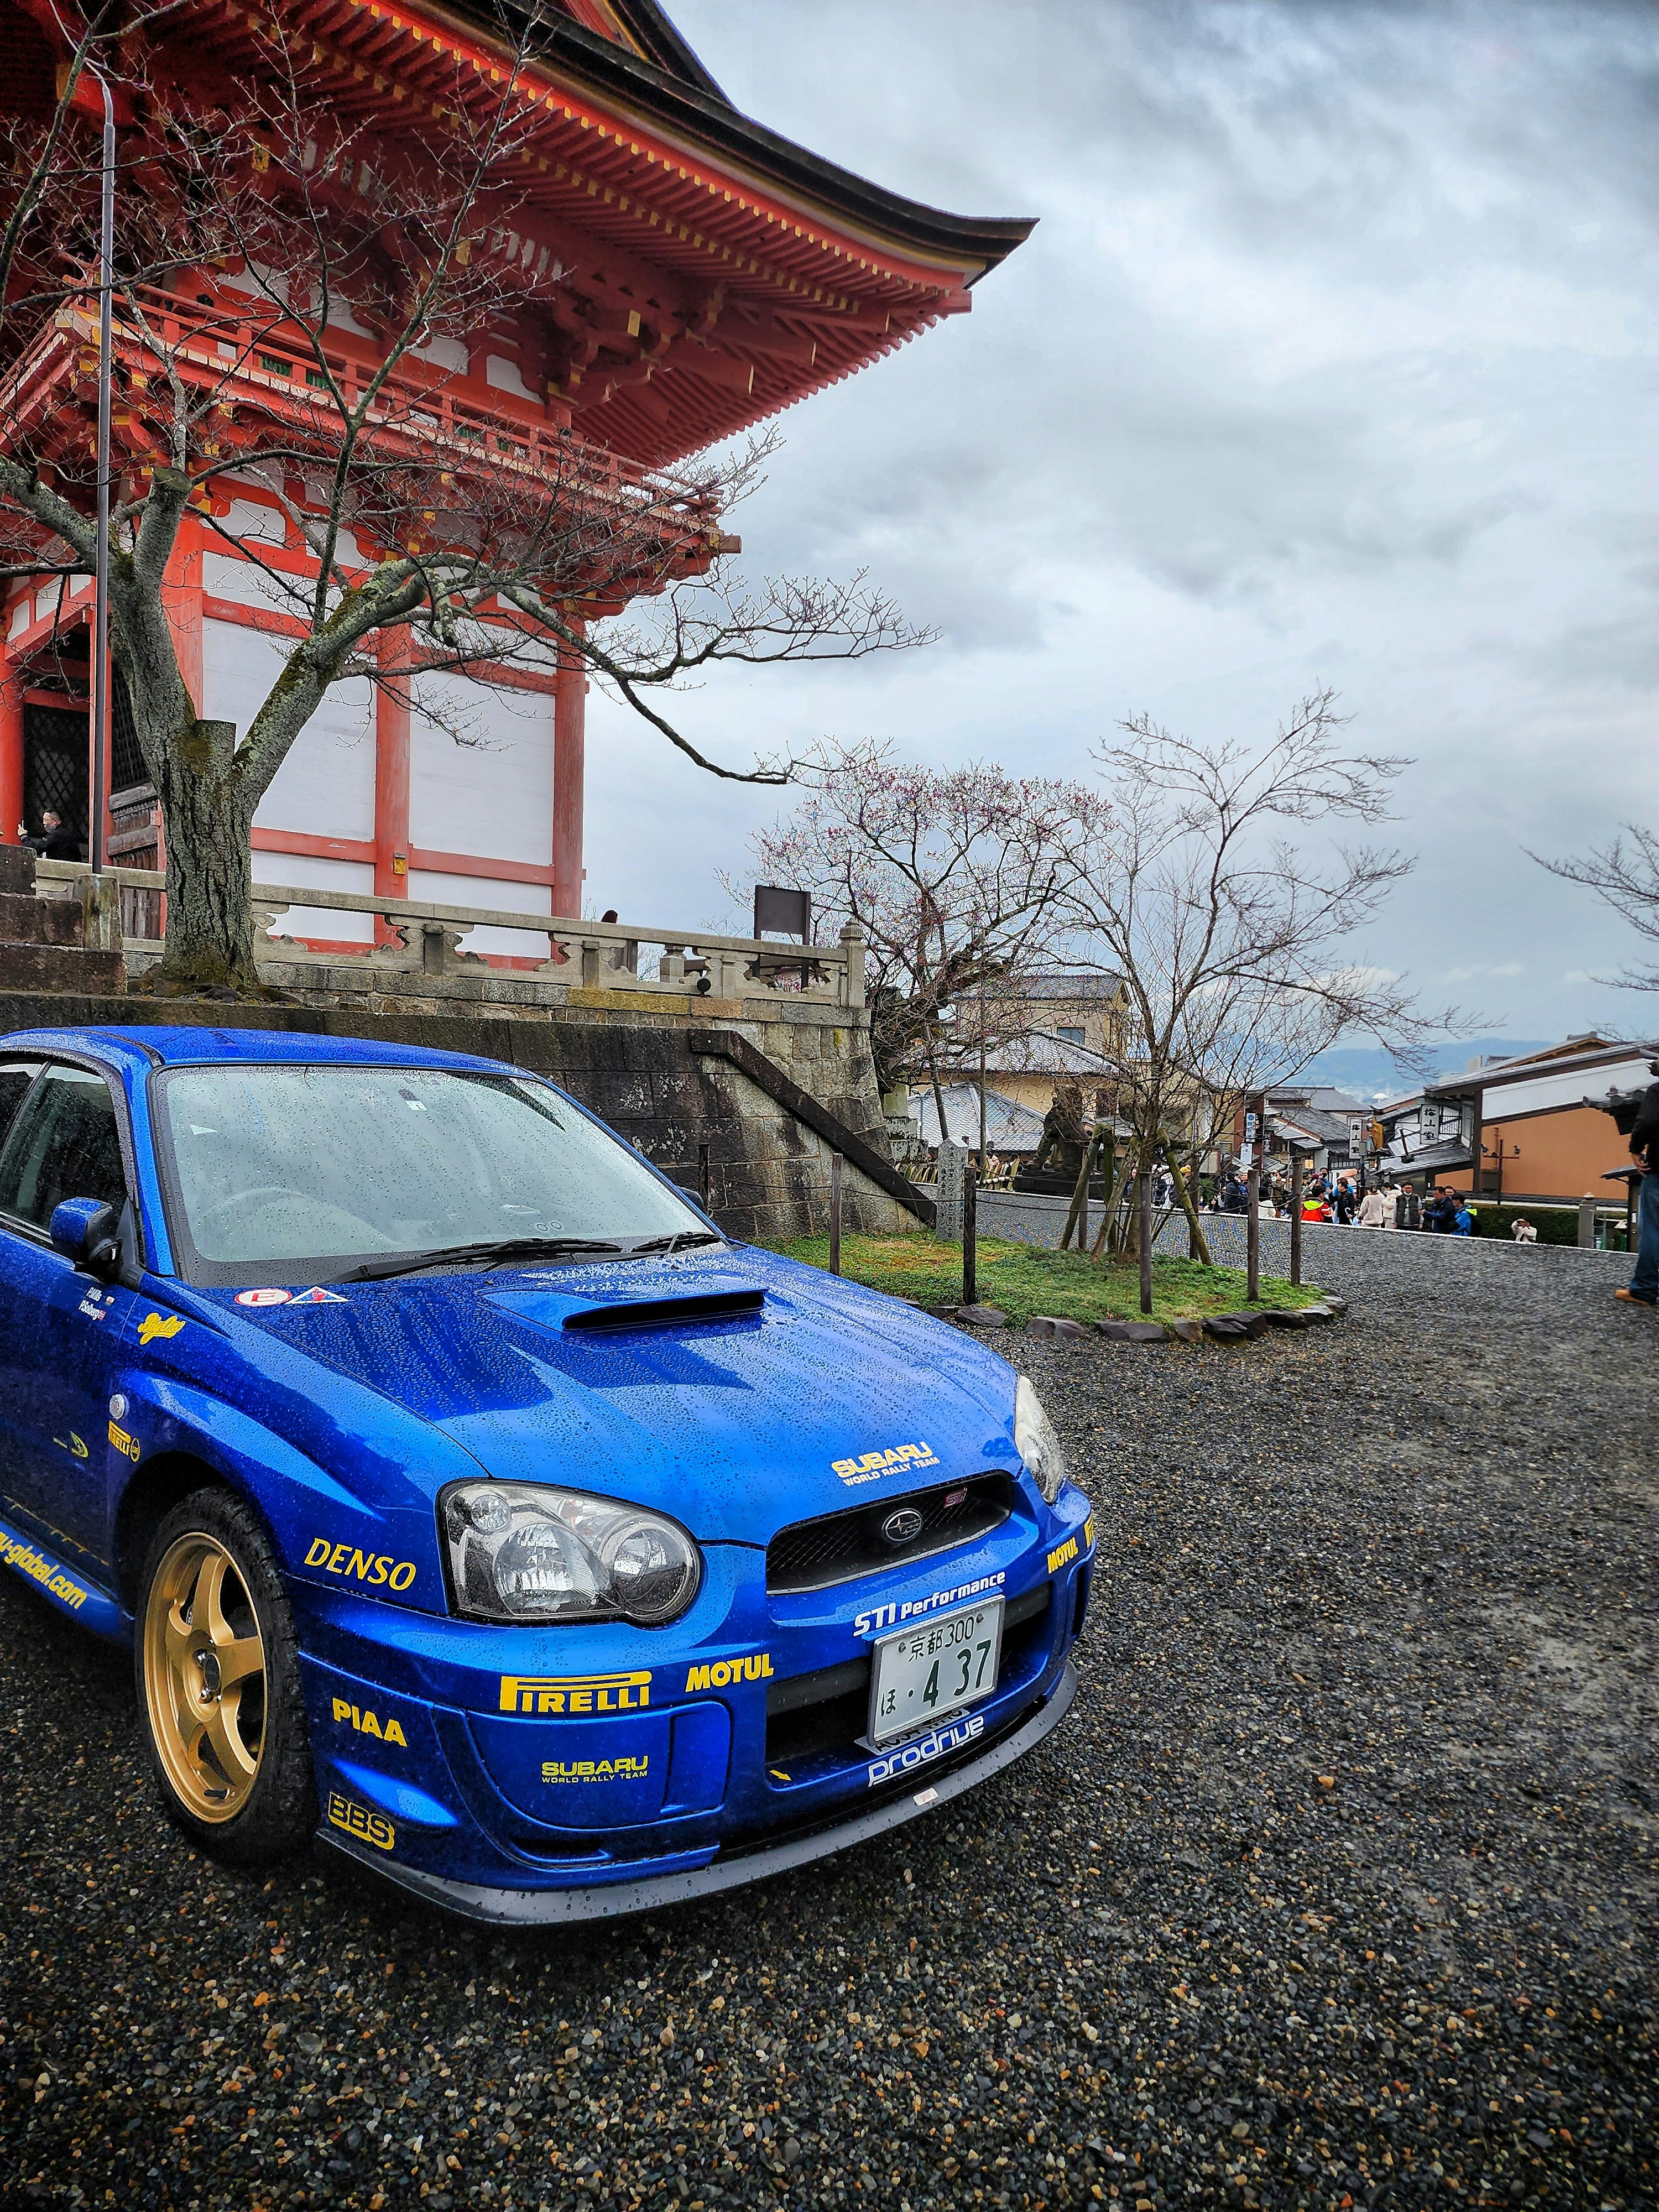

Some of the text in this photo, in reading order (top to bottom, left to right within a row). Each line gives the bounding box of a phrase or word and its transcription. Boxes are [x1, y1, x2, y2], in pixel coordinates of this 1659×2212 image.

[1424, 1108, 1437, 1141] 梅山堂
[251, 1292, 276, 1302] E
[831, 1441, 933, 1478] SUBARU
[843, 1456, 941, 1486] WORLD RALLY TEAM
[304, 1537, 416, 1590] DENSO
[1047, 1536, 1079, 1574] MOTUL
[853, 1571, 1006, 1637] STI Performance
[499, 1671, 653, 1713] PIRELLI
[685, 1653, 774, 1693] MOTUL
[332, 1697, 408, 1747] PIAA
[542, 1755, 648, 1776] SUBARU
[868, 1715, 984, 1788] prodrive
[583, 1774, 615, 1782] RALLY
[619, 1770, 648, 1779] TEAM
[328, 1791, 395, 1850] BBS
